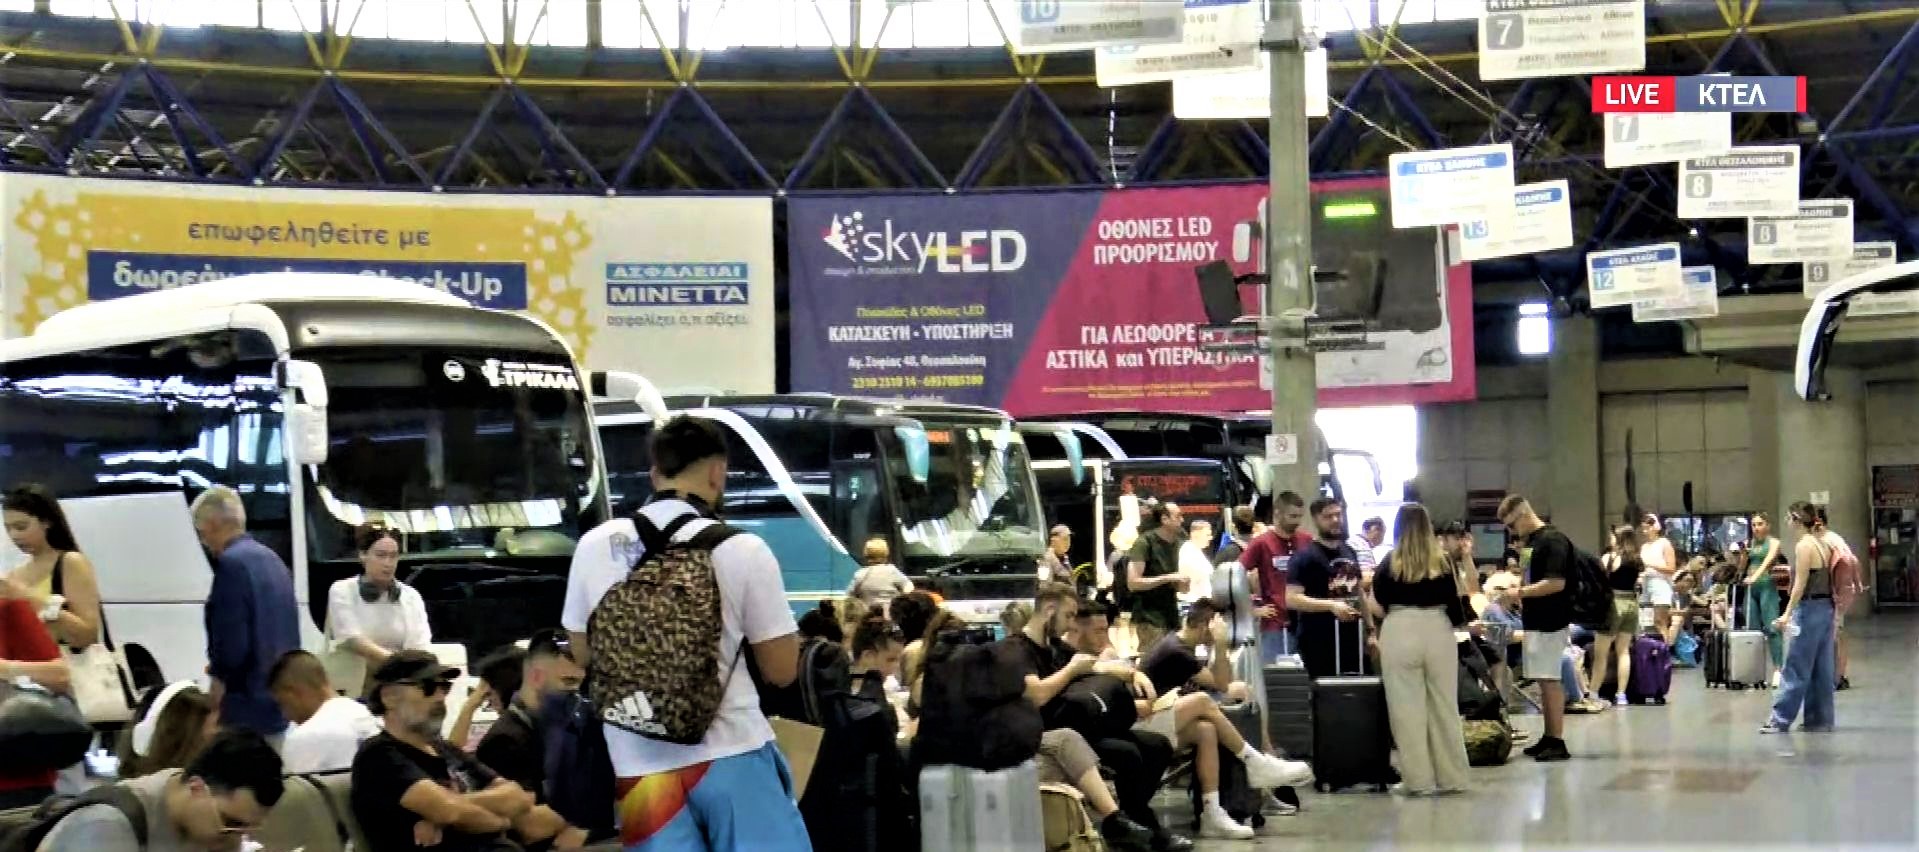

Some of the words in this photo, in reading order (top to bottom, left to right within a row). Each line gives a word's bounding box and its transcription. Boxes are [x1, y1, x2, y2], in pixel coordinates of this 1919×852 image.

[1497, 20, 1513, 45] 7
[1618, 117, 1634, 141] 7
[1693, 175, 1705, 196] 8
[188, 221, 389, 248] επωφεληθείτε
[399, 230, 430, 249] με
[1099, 219, 1173, 240] ΟΘΟΝΕΣ
[1178, 217, 1211, 237] LED
[863, 220, 1027, 274] skyLED
[1094, 242, 1219, 265] ΠΡΟΟΡΙΣΜΟΥ
[613, 266, 741, 278] ΑΣΦΑΛΕΙΑΙ
[1595, 272, 1613, 289] 12
[359, 270, 503, 300] ck-Up
[829, 325, 910, 341] ΚΑΤΑΣΚΕΥΗ
[924, 323, 1013, 339] ΥΠΟΣΤΗΡΙΞΗ
[1081, 325, 1108, 345] ΓΙΑ
[1112, 323, 1214, 344] ΛΕΩΦΟΡΕΑ
[1046, 350, 1109, 369] ΑΣΤΙΚΑ
[1116, 353, 1144, 367] και
[503, 371, 580, 390] ΤΡΙΚΑΛΑ
